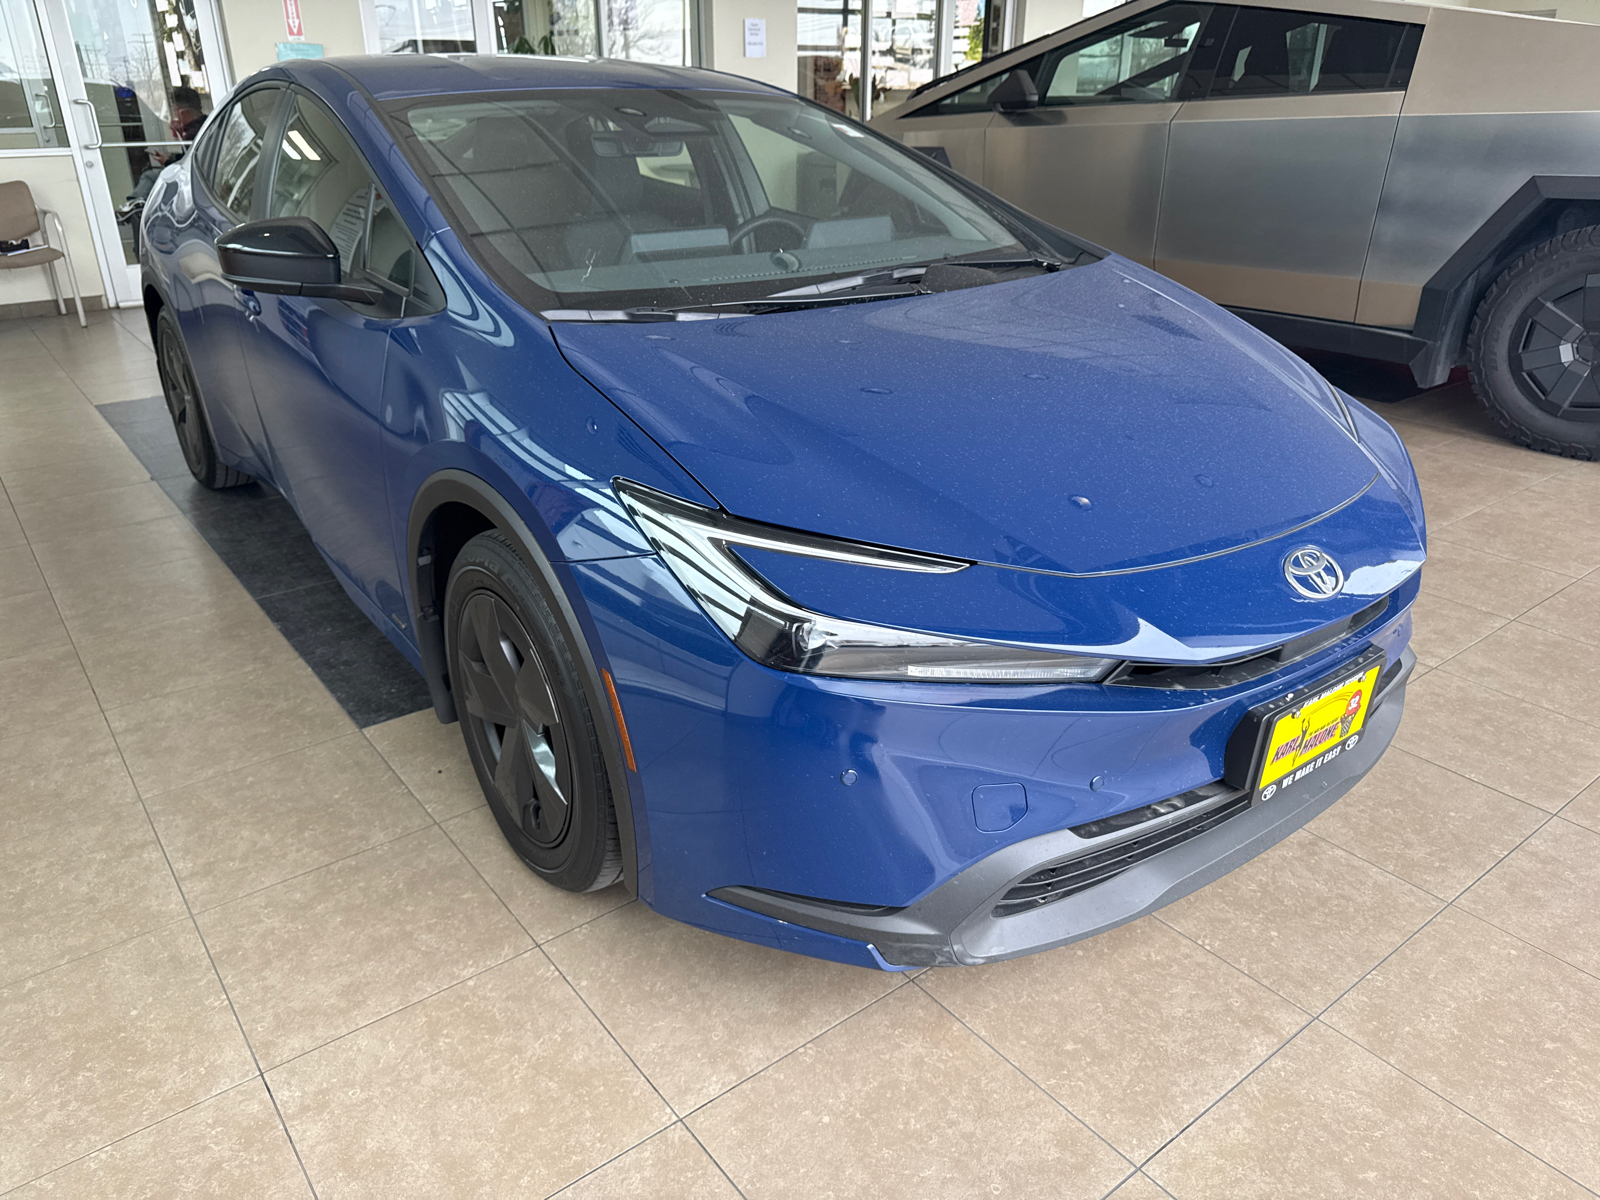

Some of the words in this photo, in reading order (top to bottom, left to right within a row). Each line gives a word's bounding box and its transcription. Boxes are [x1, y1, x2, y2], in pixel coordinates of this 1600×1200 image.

[1348, 695, 1360, 711] 32
[1270, 734, 1301, 766] KARL
[1299, 721, 1340, 758] MALONE
[1281, 773, 1295, 789] WE
[1294, 761, 1316, 782] MAKE
[1315, 756, 1324, 769] IT
